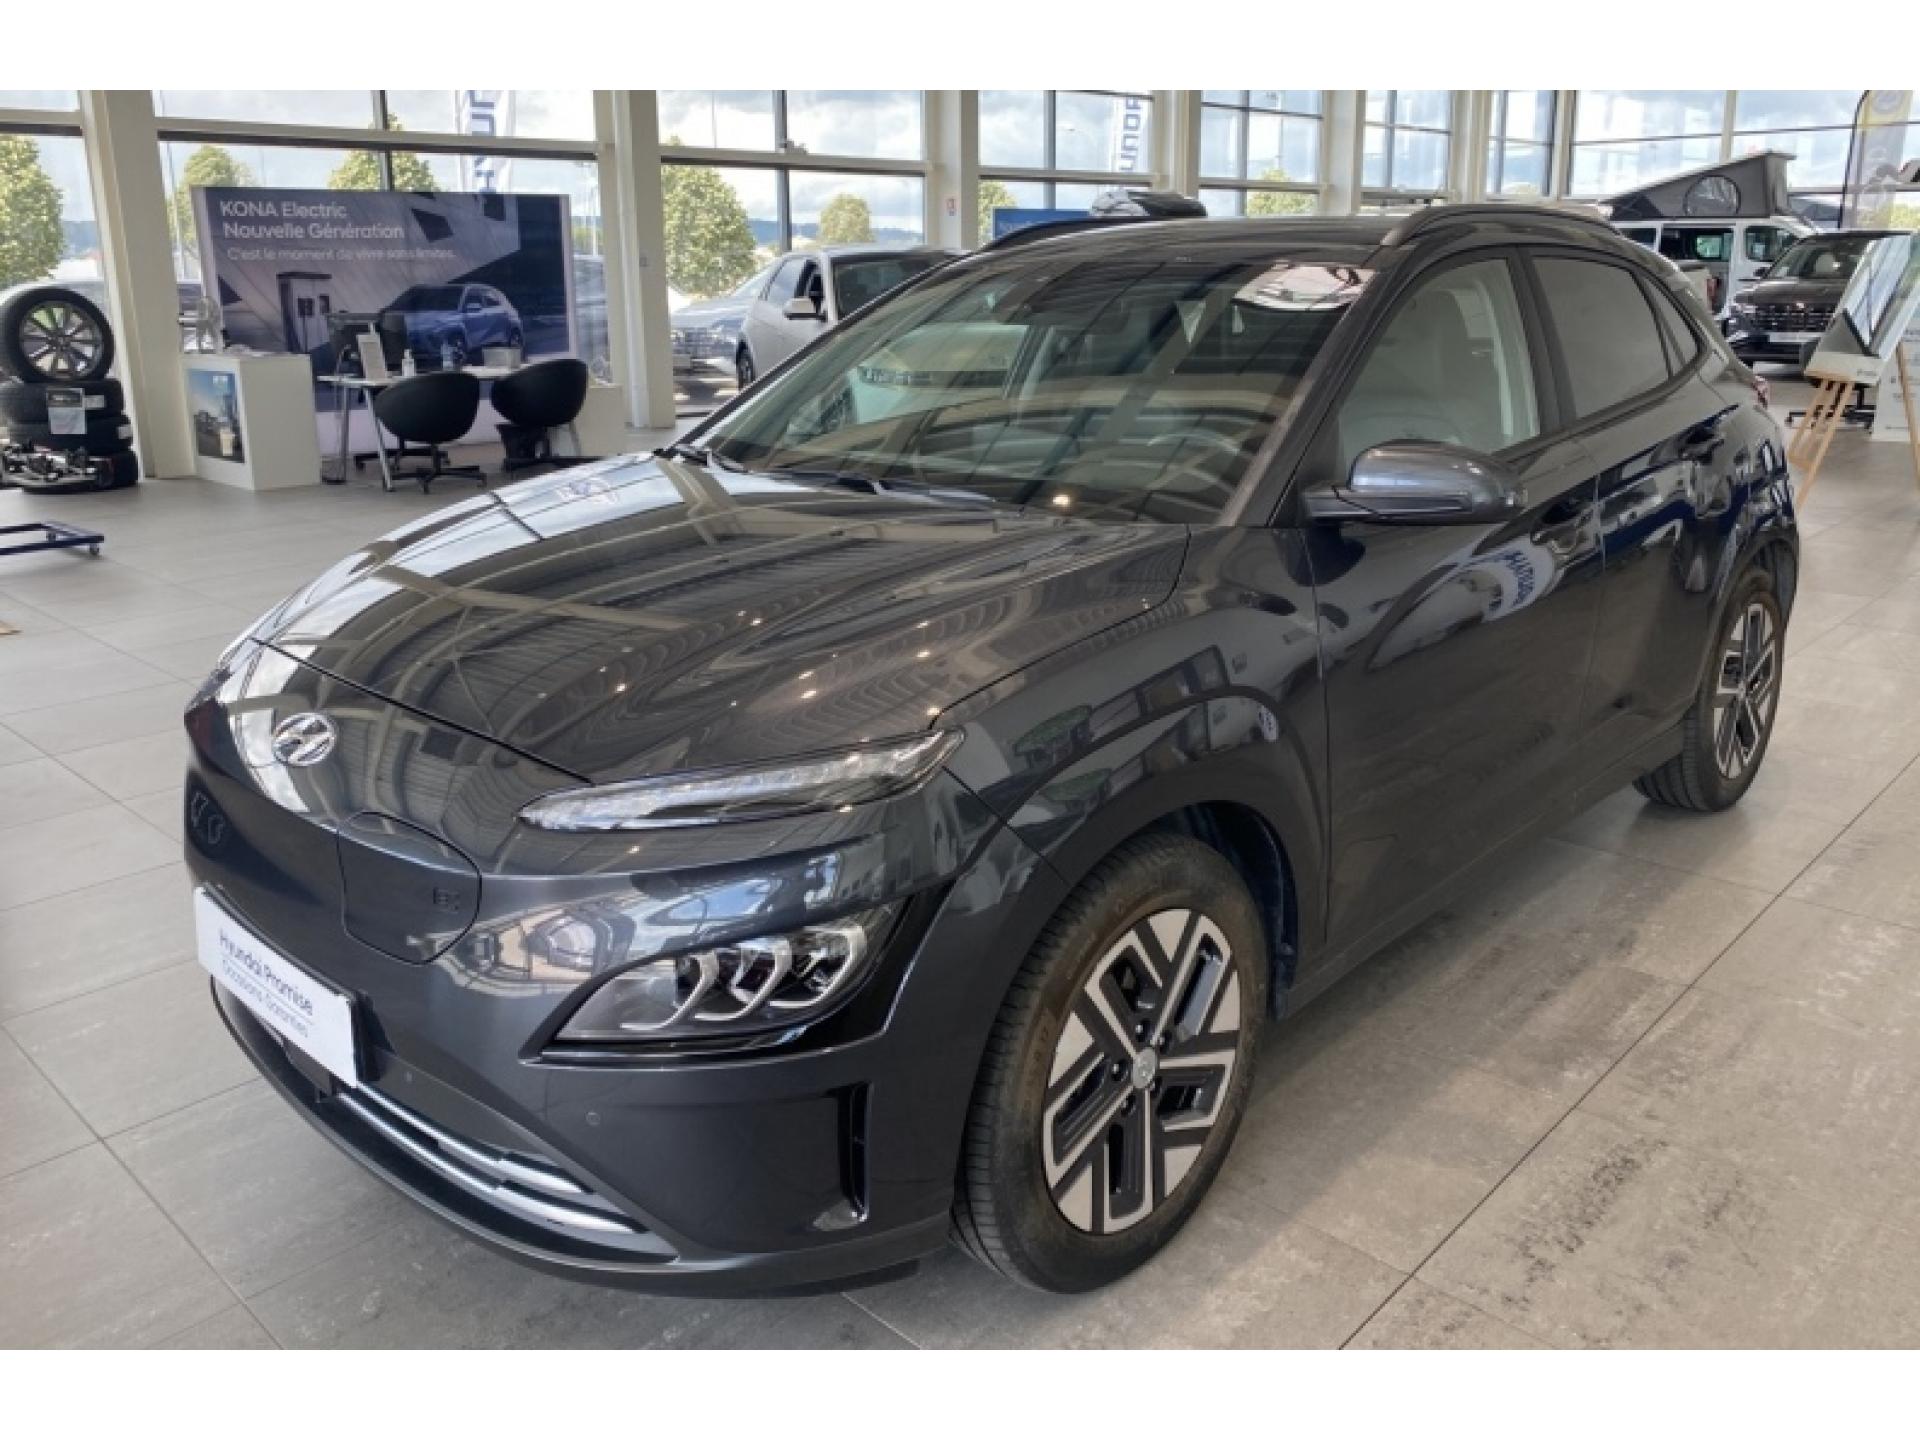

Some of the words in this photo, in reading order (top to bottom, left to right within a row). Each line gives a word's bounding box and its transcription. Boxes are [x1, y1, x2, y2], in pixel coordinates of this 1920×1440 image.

[221, 200, 279, 216] KONA
[282, 200, 347, 217] Electric
[223, 221, 304, 239] Nouvelle
[308, 222, 404, 239] Génération
[227, 246, 260, 260] C'est
[279, 248, 337, 260] moment
[219, 927, 262, 976] Hyundai
[263, 964, 313, 1016] Promise
